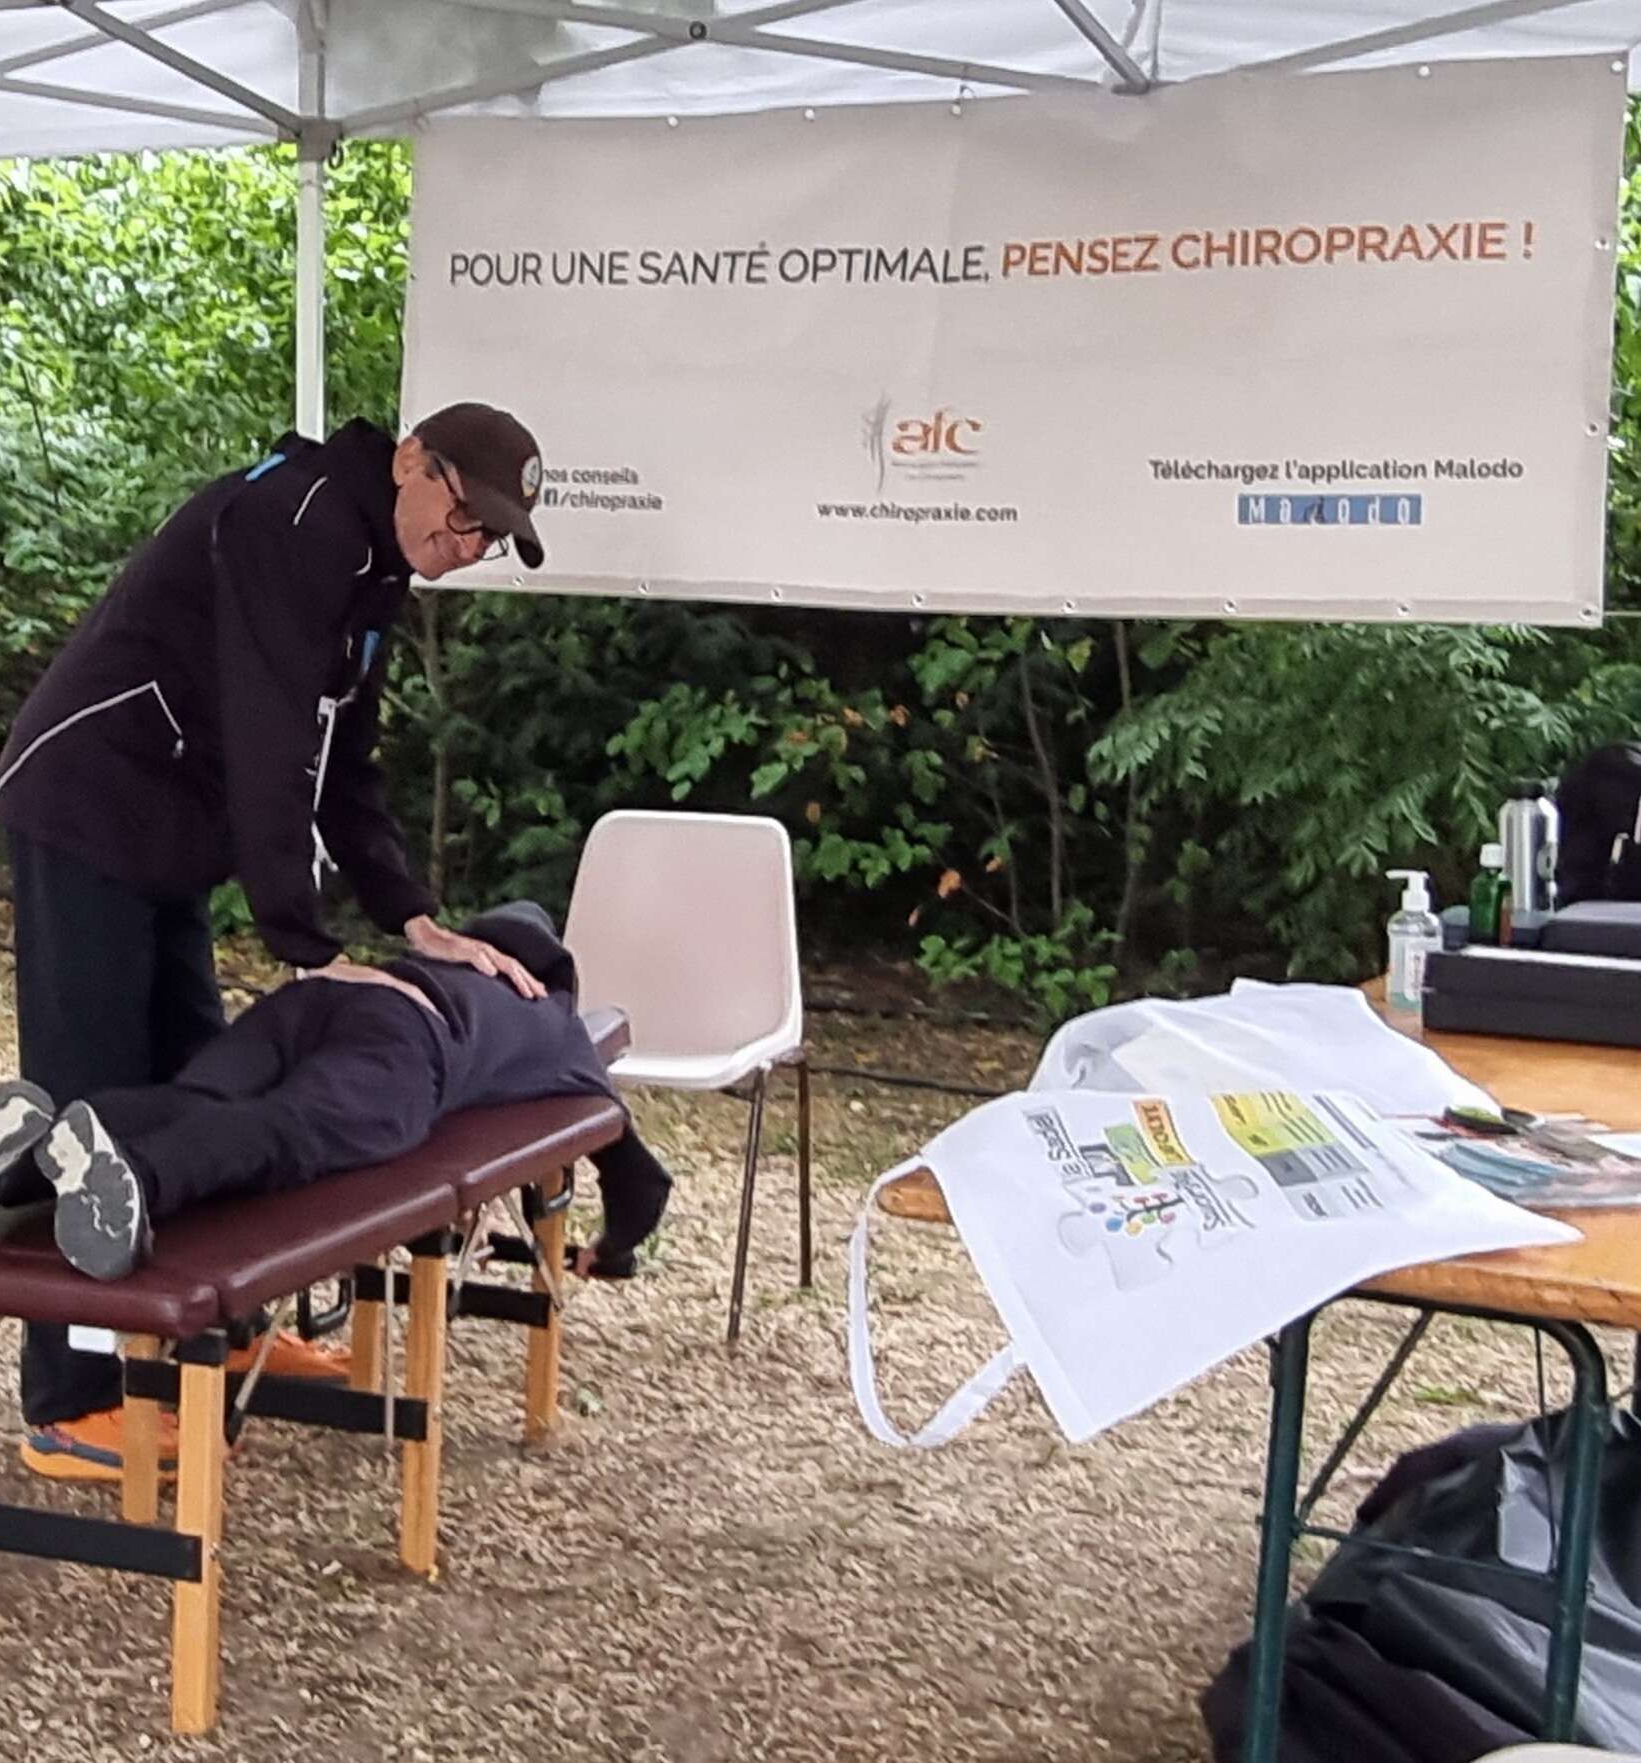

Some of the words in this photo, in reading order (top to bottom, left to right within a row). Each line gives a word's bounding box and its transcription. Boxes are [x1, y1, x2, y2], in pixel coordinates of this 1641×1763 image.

[449, 251, 544, 287] POUR
[551, 250, 631, 286] UNE
[637, 242, 768, 286] SANTÉ
[777, 244, 991, 285] OPTIMALE,
[1000, 235, 1161, 279] PENSEZ
[1169, 221, 1509, 270] CHIROPRAXIE
[1521, 221, 1536, 261] !
[571, 465, 640, 486] conseils
[1148, 457, 1280, 485] Téléchargez
[1284, 458, 1428, 485] l'application
[1433, 458, 1524, 480] Malodo
[816, 501, 1019, 524] www.chiropraxie.com
